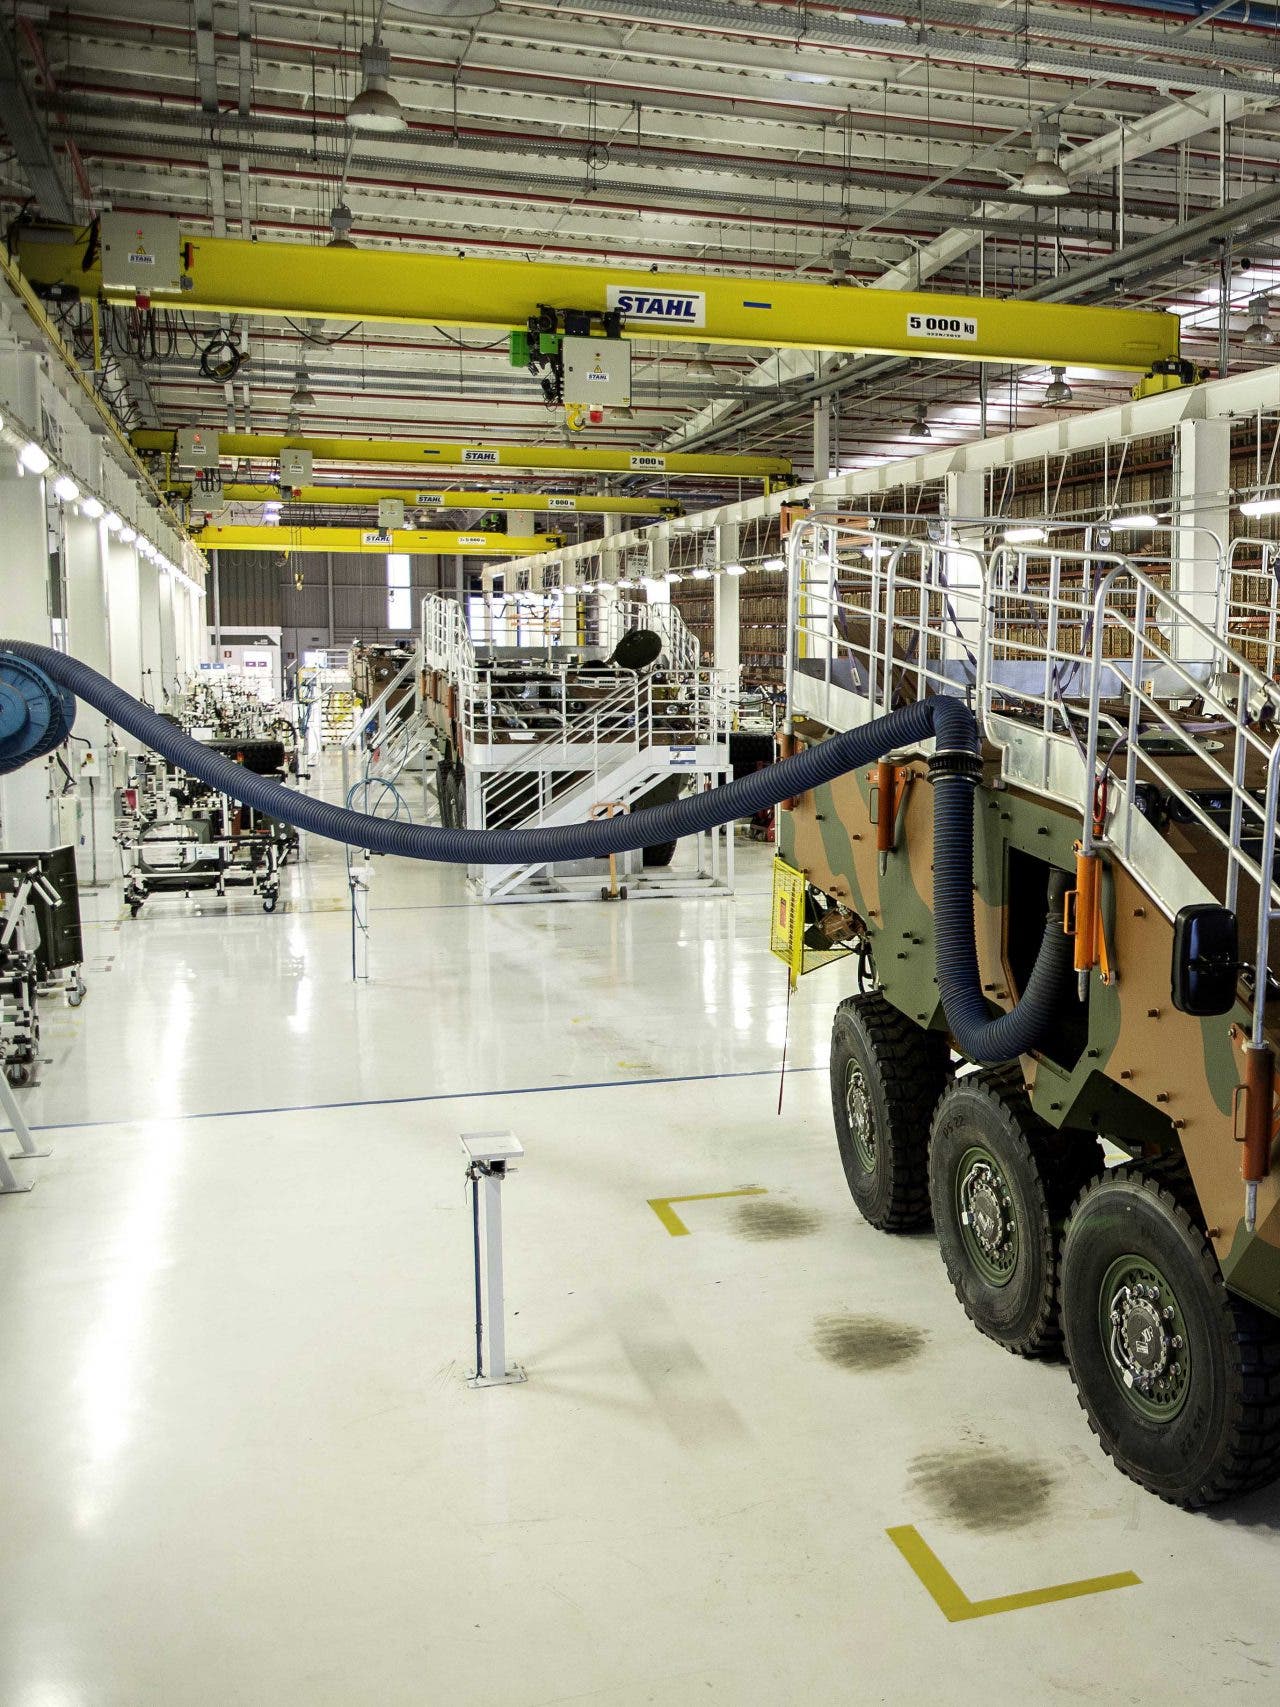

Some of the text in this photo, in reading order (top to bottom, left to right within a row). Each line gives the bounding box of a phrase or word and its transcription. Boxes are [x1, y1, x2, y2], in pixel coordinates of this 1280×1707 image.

[130, 255, 153, 263] STAHL
[617, 296, 697, 317] STAHL
[910, 316, 975, 335] 5 000 kg
[465, 452, 496, 460] STAHL
[639, 457, 657, 465] 000
